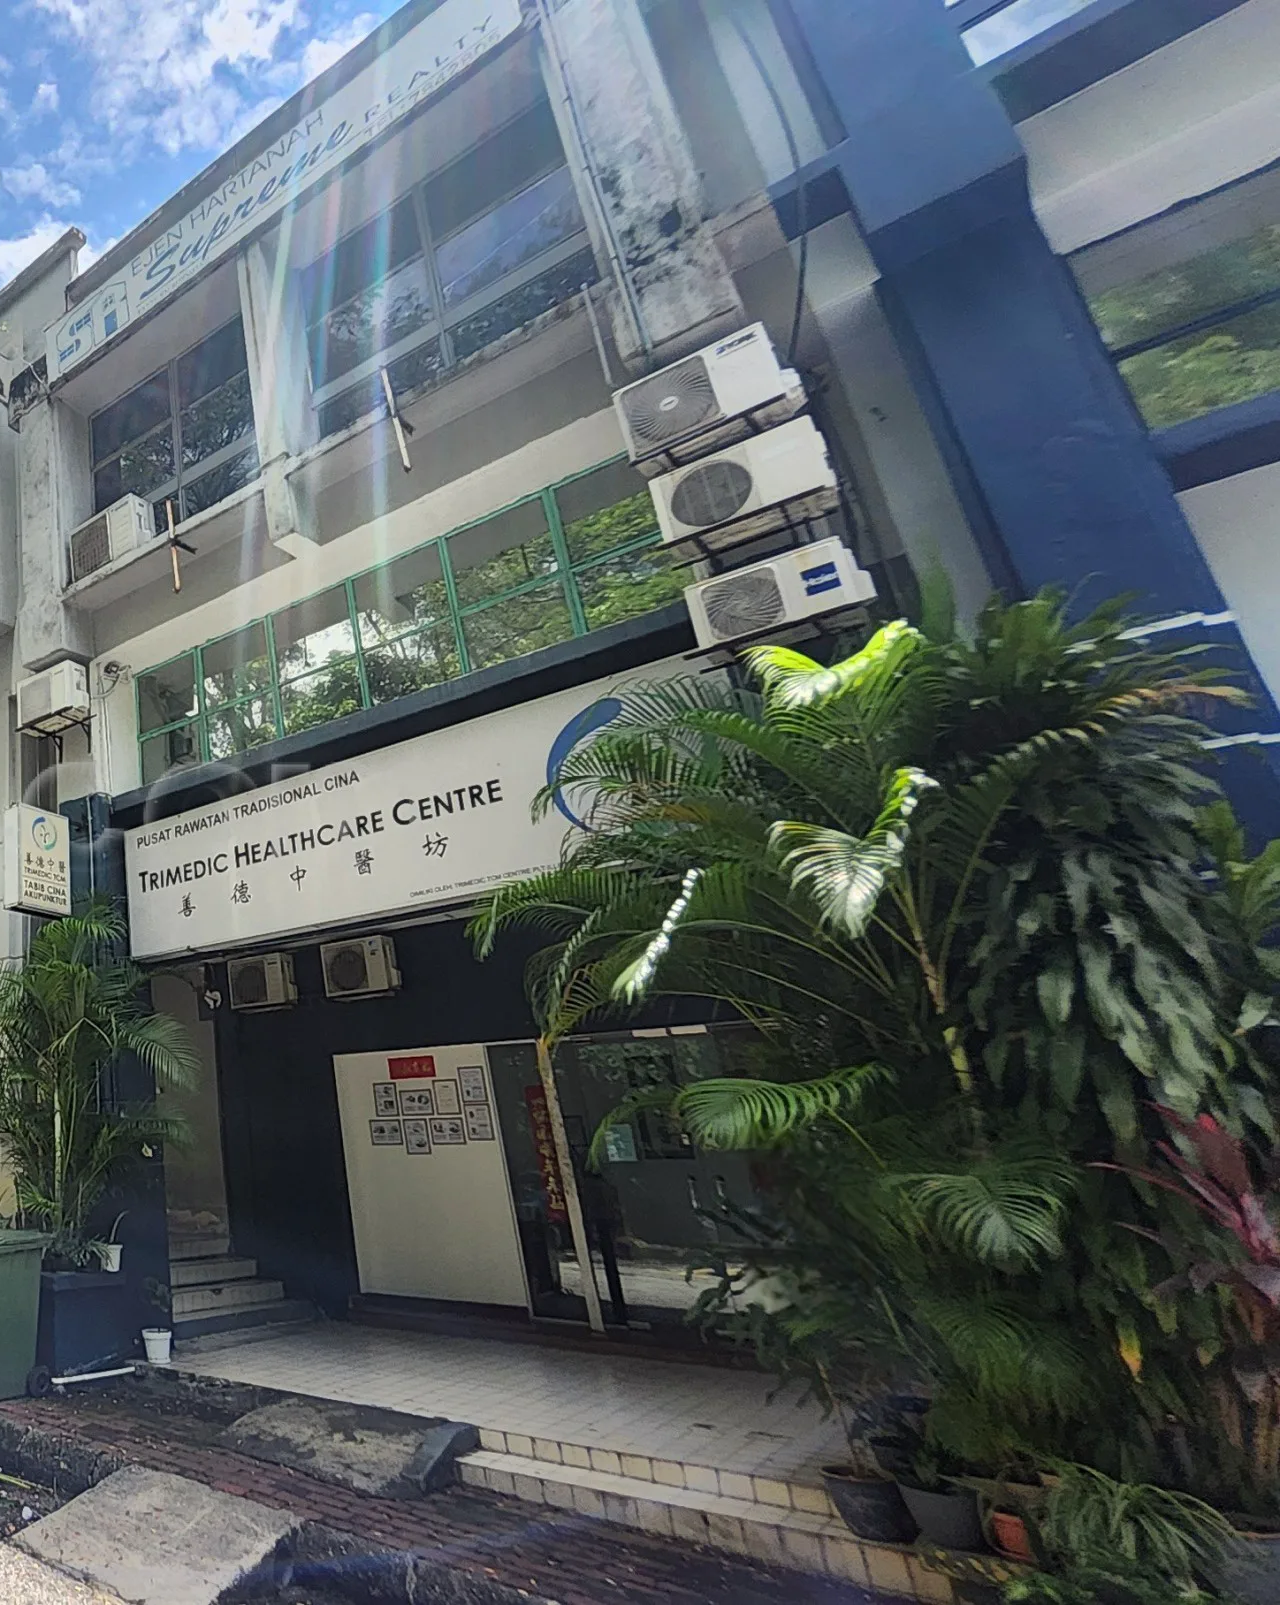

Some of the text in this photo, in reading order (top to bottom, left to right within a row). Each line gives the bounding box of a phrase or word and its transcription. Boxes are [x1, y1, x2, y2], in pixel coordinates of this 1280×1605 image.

[364, 14, 493, 123] REALTY
[130, 108, 324, 277] EJEN HARTANAH
[139, 119, 354, 300] Supreme
[136, 770, 360, 849] PUSAT RAWATAN TRADISIONAL CINA
[138, 779, 504, 893] TRIMEDIC HEALTHCARE CENTRE
[24, 866, 52, 879] TRIMEDIC
[24, 880, 67, 897] TABIB CINA
[24, 890, 67, 906] AKUPUNKTUR
[178, 831, 450, 918] 善德中醫坊
